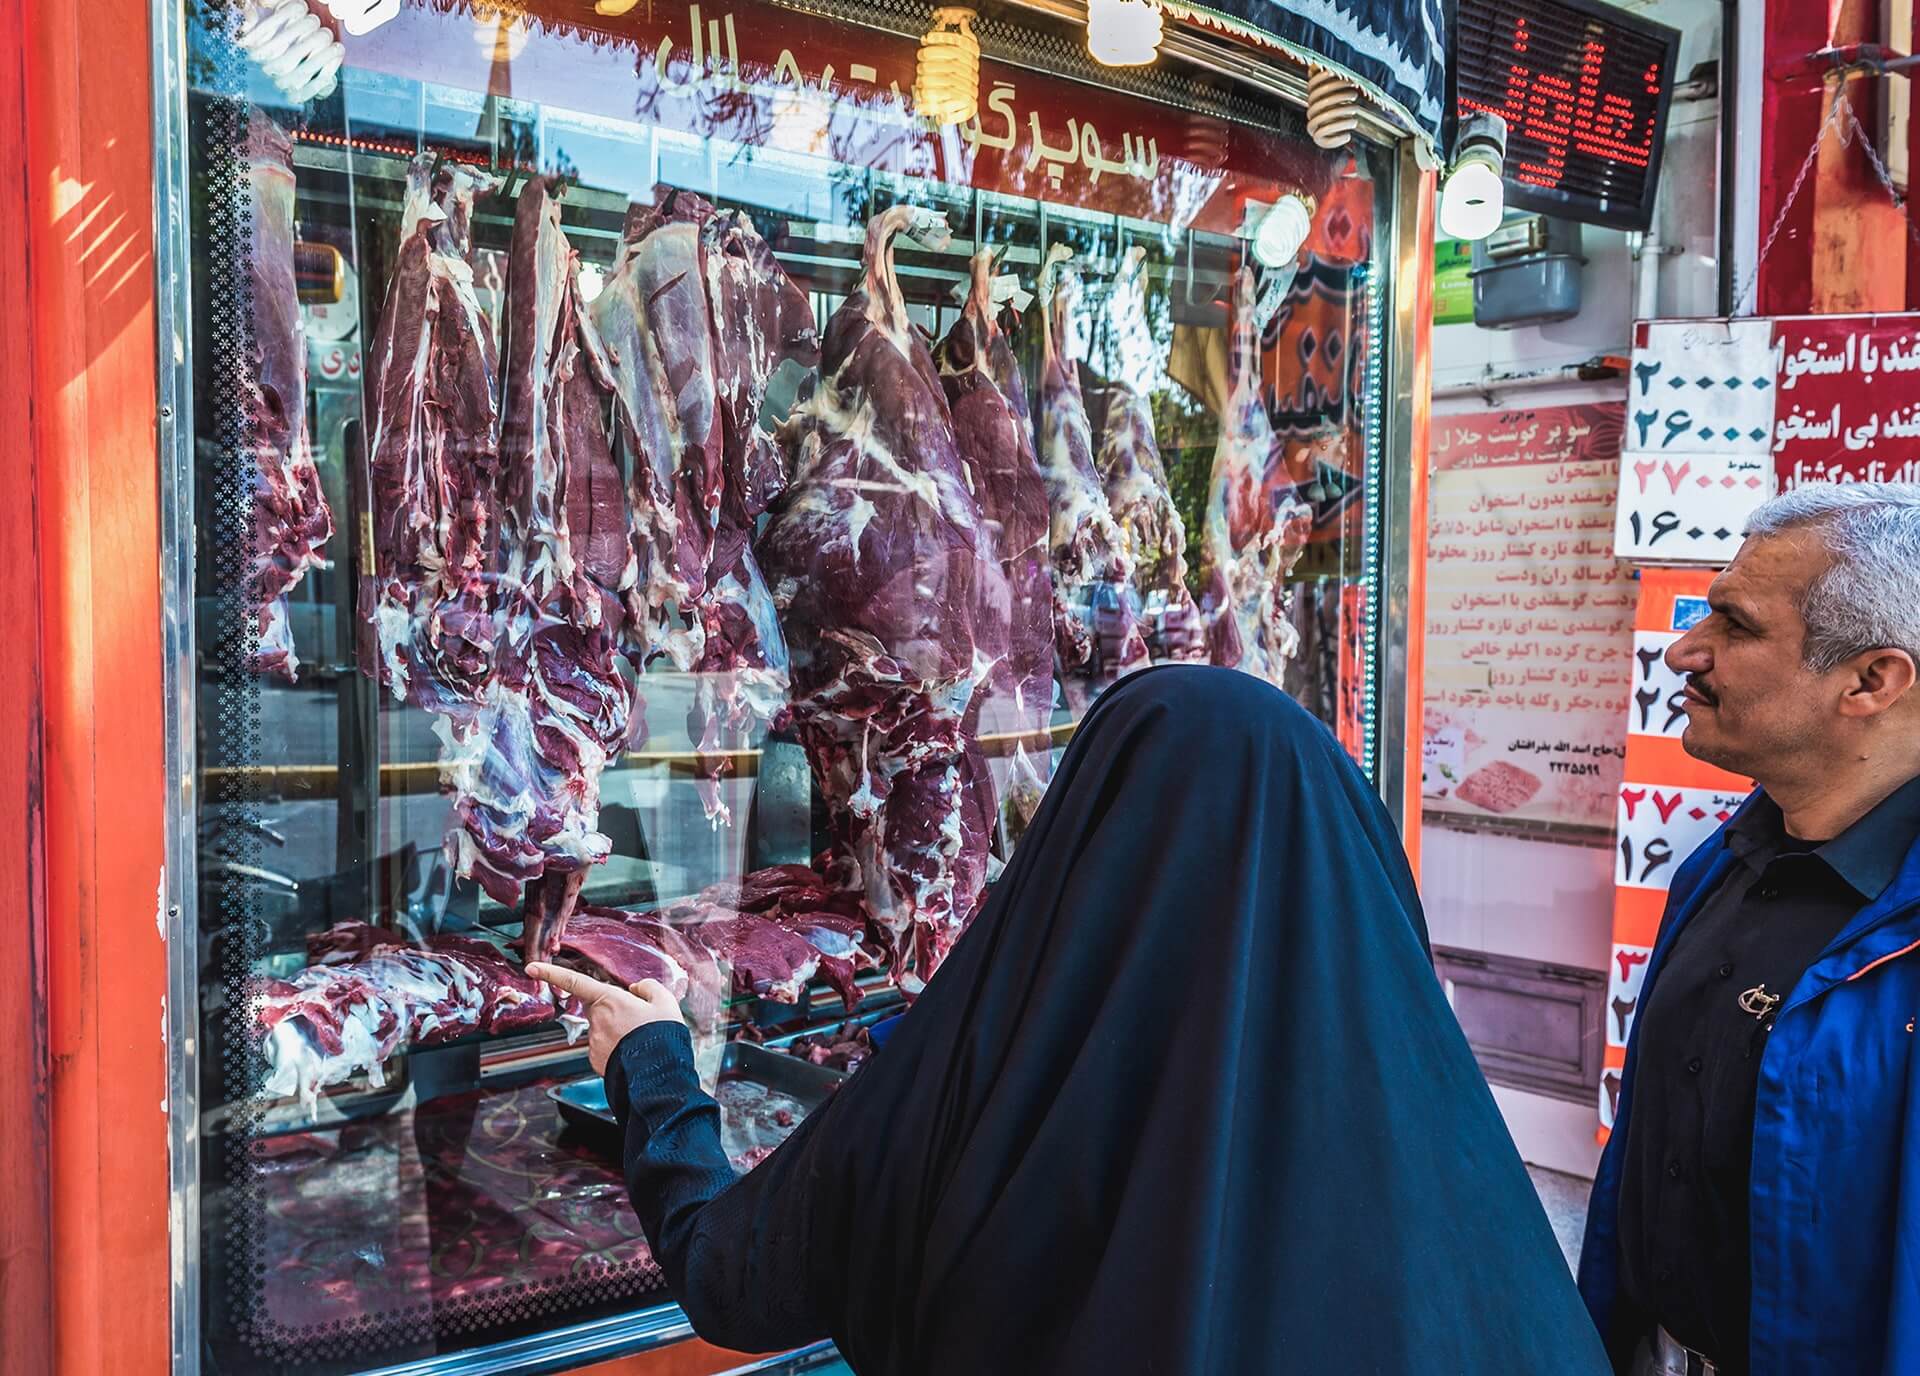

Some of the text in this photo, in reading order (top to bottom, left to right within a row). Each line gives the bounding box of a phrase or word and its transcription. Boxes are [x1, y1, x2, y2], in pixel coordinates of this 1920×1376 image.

[1026, 110, 1159, 189] سوپر
[1777, 332, 1857, 390] استخوا
[1859, 333, 1879, 383] با
[1634, 361, 1772, 396] ۲۰۰۰۰
[1487, 420, 1540, 447] گوشت
[1634, 409, 1768, 448] ۲۶۰۰۰
[1773, 402, 1841, 452] استخو
[1844, 412, 1879, 450] بی
[1634, 458, 1762, 496] ۲۷۰۰۰
